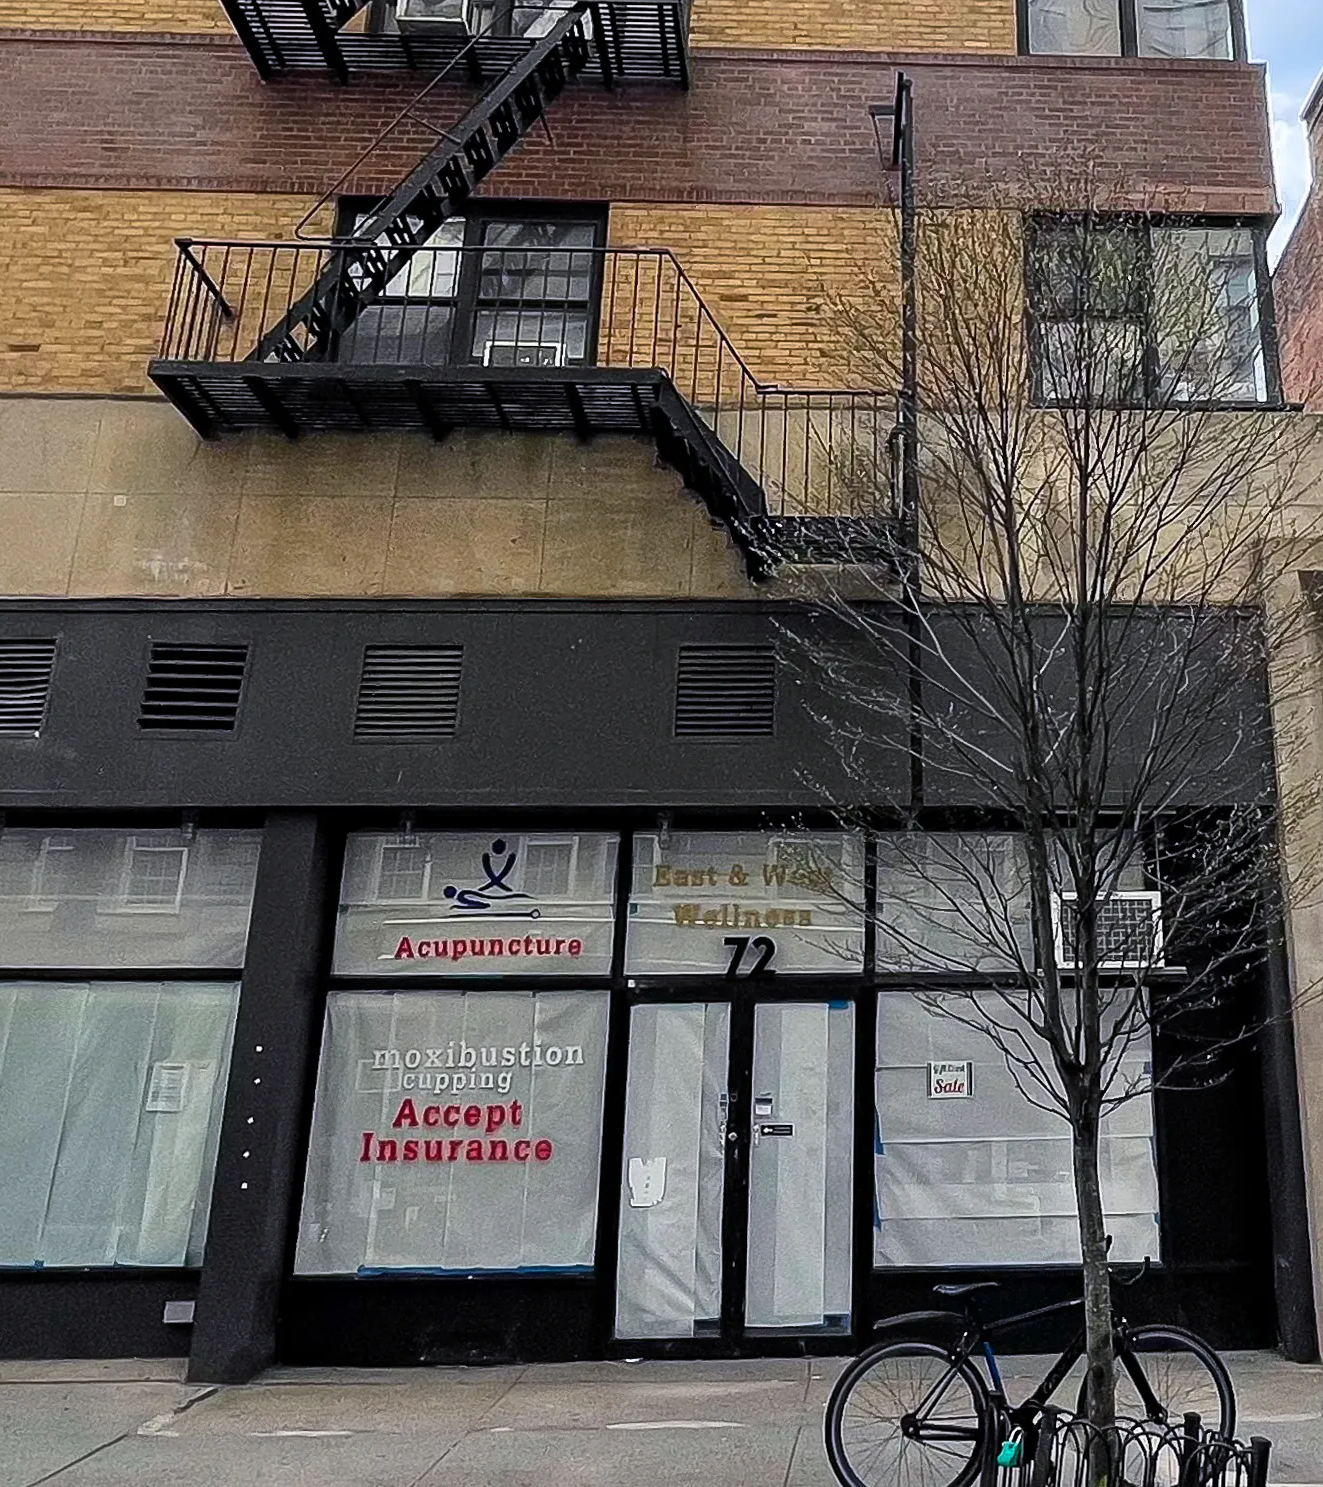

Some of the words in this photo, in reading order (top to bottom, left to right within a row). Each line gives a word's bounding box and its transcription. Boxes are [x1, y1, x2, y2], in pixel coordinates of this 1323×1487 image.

[653, 863, 718, 888] East
[728, 863, 750, 887] &
[394, 935, 584, 962] Acupuncture
[723, 936, 777, 979] 72
[372, 1040, 585, 1070] moxibustion
[403, 1067, 513, 1095] cupping
[934, 1078, 966, 1094] Sale
[392, 1097, 523, 1133] Accept
[360, 1132, 554, 1163] Insurance
